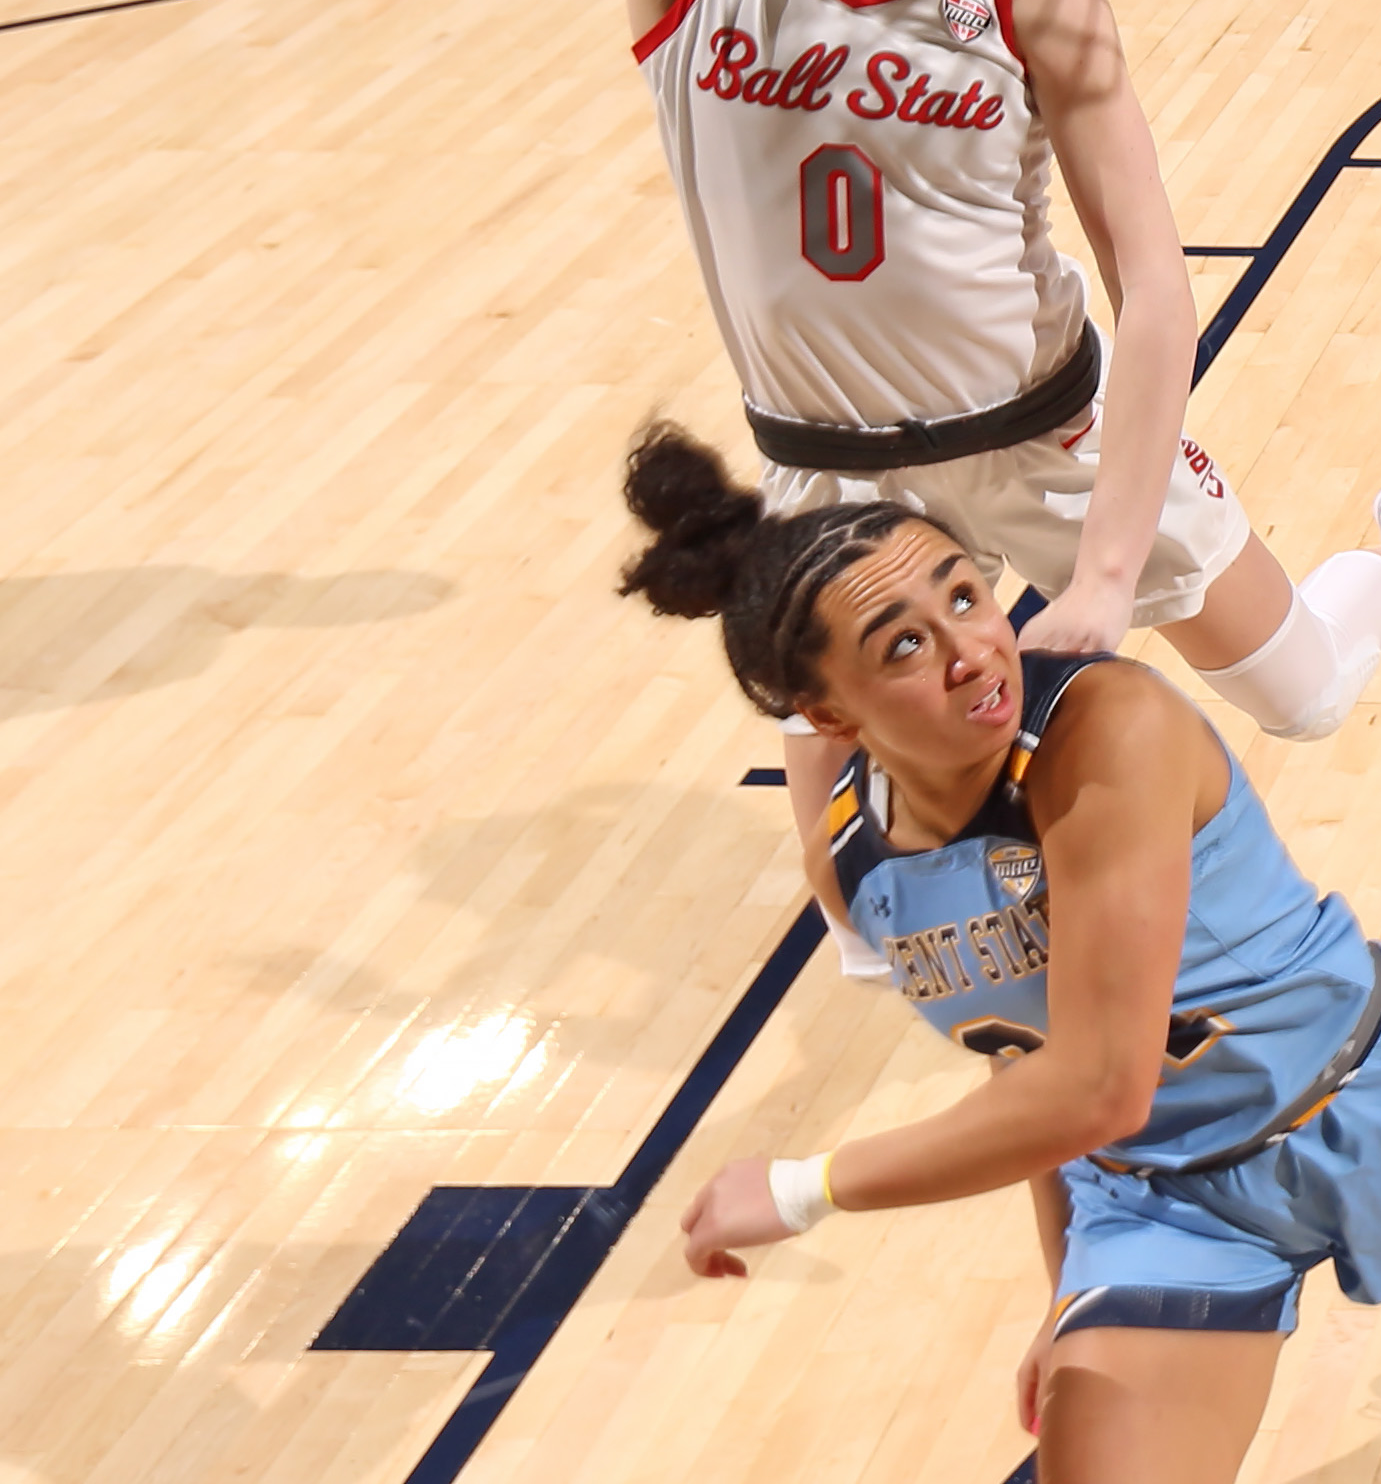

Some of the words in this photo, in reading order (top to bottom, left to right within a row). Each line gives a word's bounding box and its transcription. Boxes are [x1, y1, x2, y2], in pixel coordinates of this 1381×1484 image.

[945, 4, 989, 30] MAC
[697, 27, 851, 112] Ball
[845, 50, 1006, 131] State
[800, 143, 886, 283] 0
[994, 857, 1039, 876] MAC
[965, 893, 1050, 988] STAT
